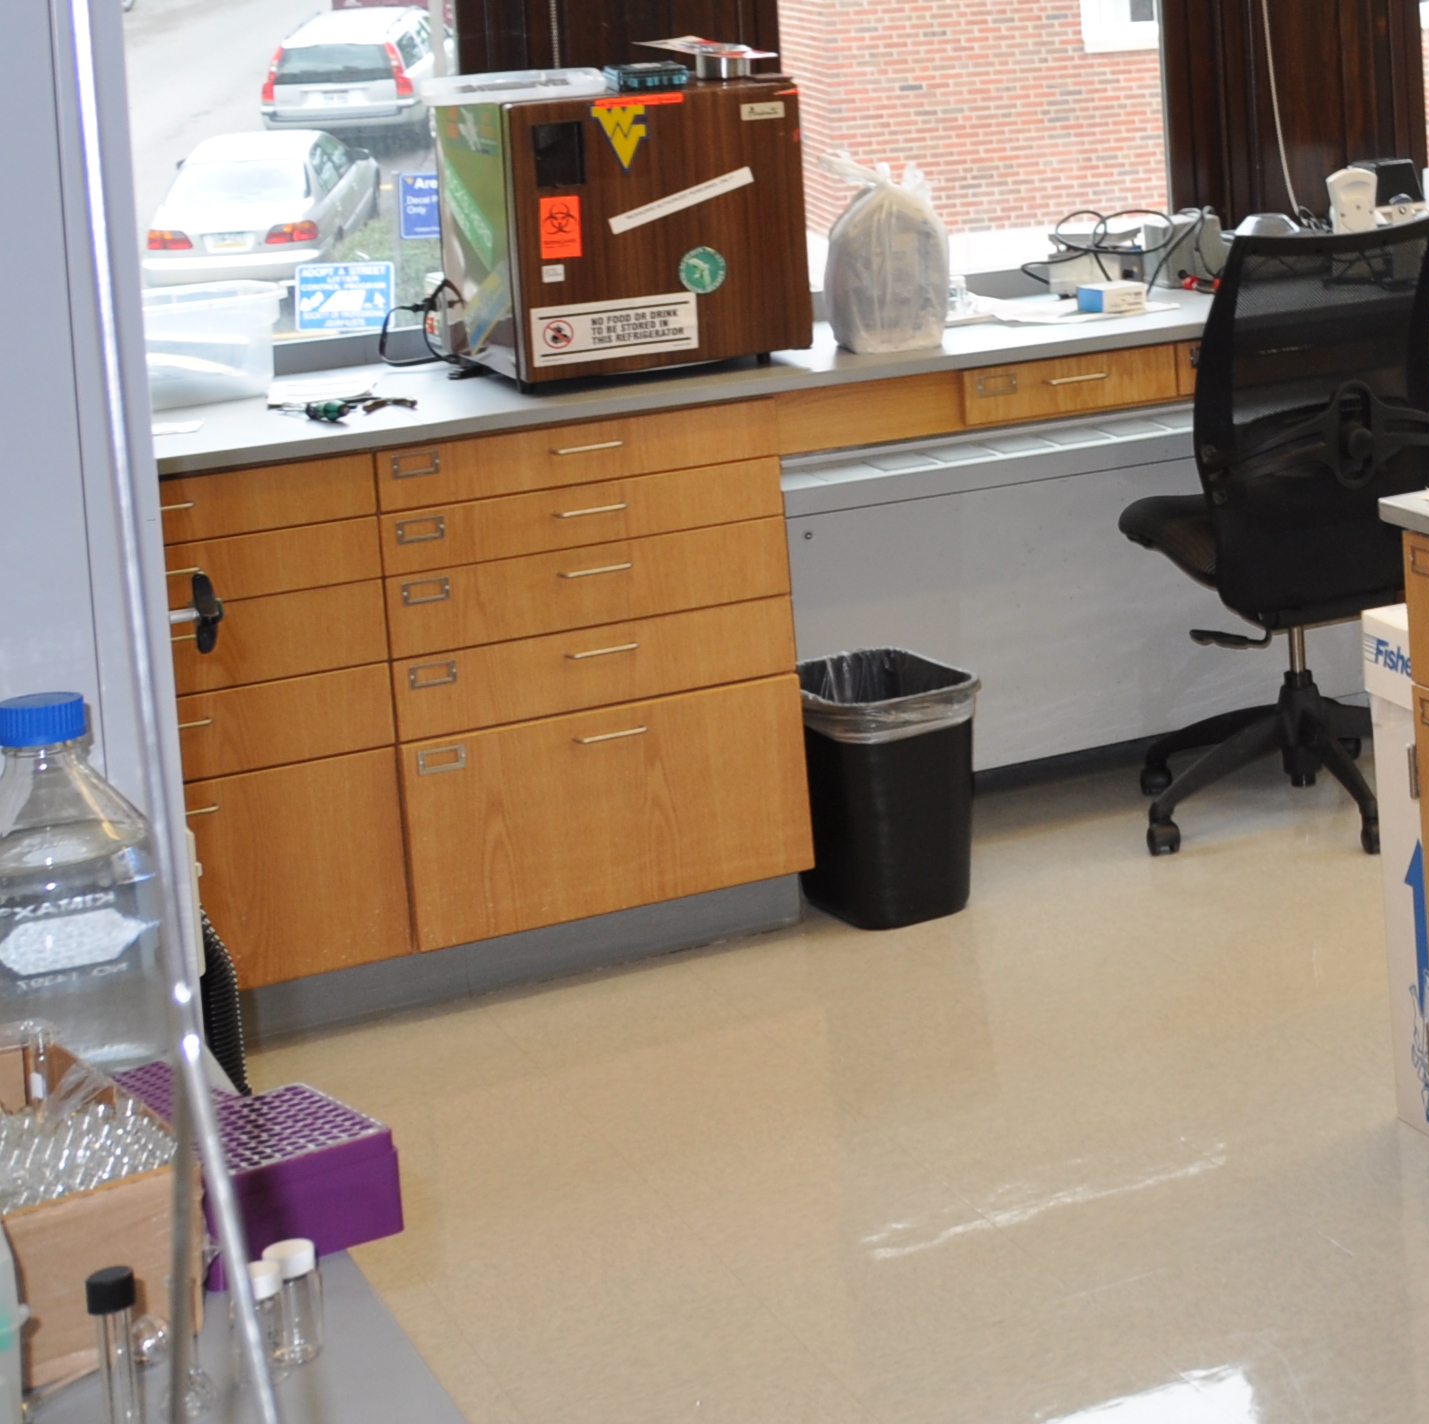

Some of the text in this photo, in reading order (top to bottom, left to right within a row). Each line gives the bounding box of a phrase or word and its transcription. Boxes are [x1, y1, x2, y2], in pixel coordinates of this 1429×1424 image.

[301, 267, 334, 278] ADOPT
[348, 265, 386, 275] STREET
[591, 309, 679, 326] NO FOOD OR DRINK
[591, 319, 669, 336] TO BE STORED IN
[592, 327, 685, 345] THIS REFRIGERATOR
